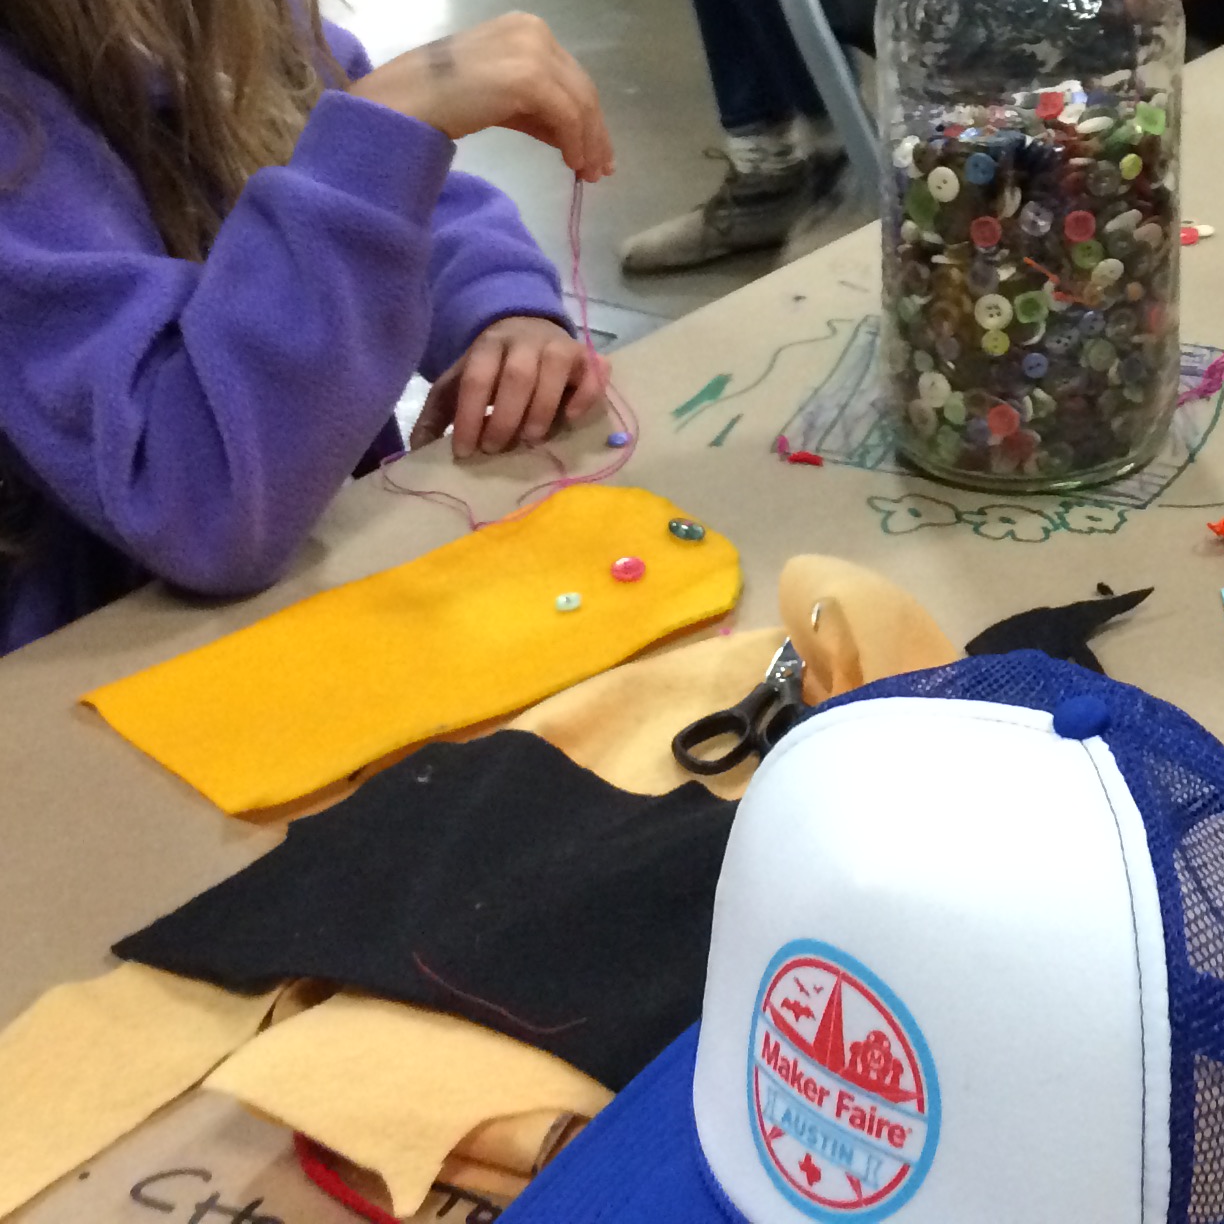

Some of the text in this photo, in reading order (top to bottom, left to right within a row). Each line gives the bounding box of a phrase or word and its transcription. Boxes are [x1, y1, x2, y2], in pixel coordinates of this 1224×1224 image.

[762, 1030, 907, 1148] Maker Faire
[781, 1108, 854, 1165] AUSTIN
